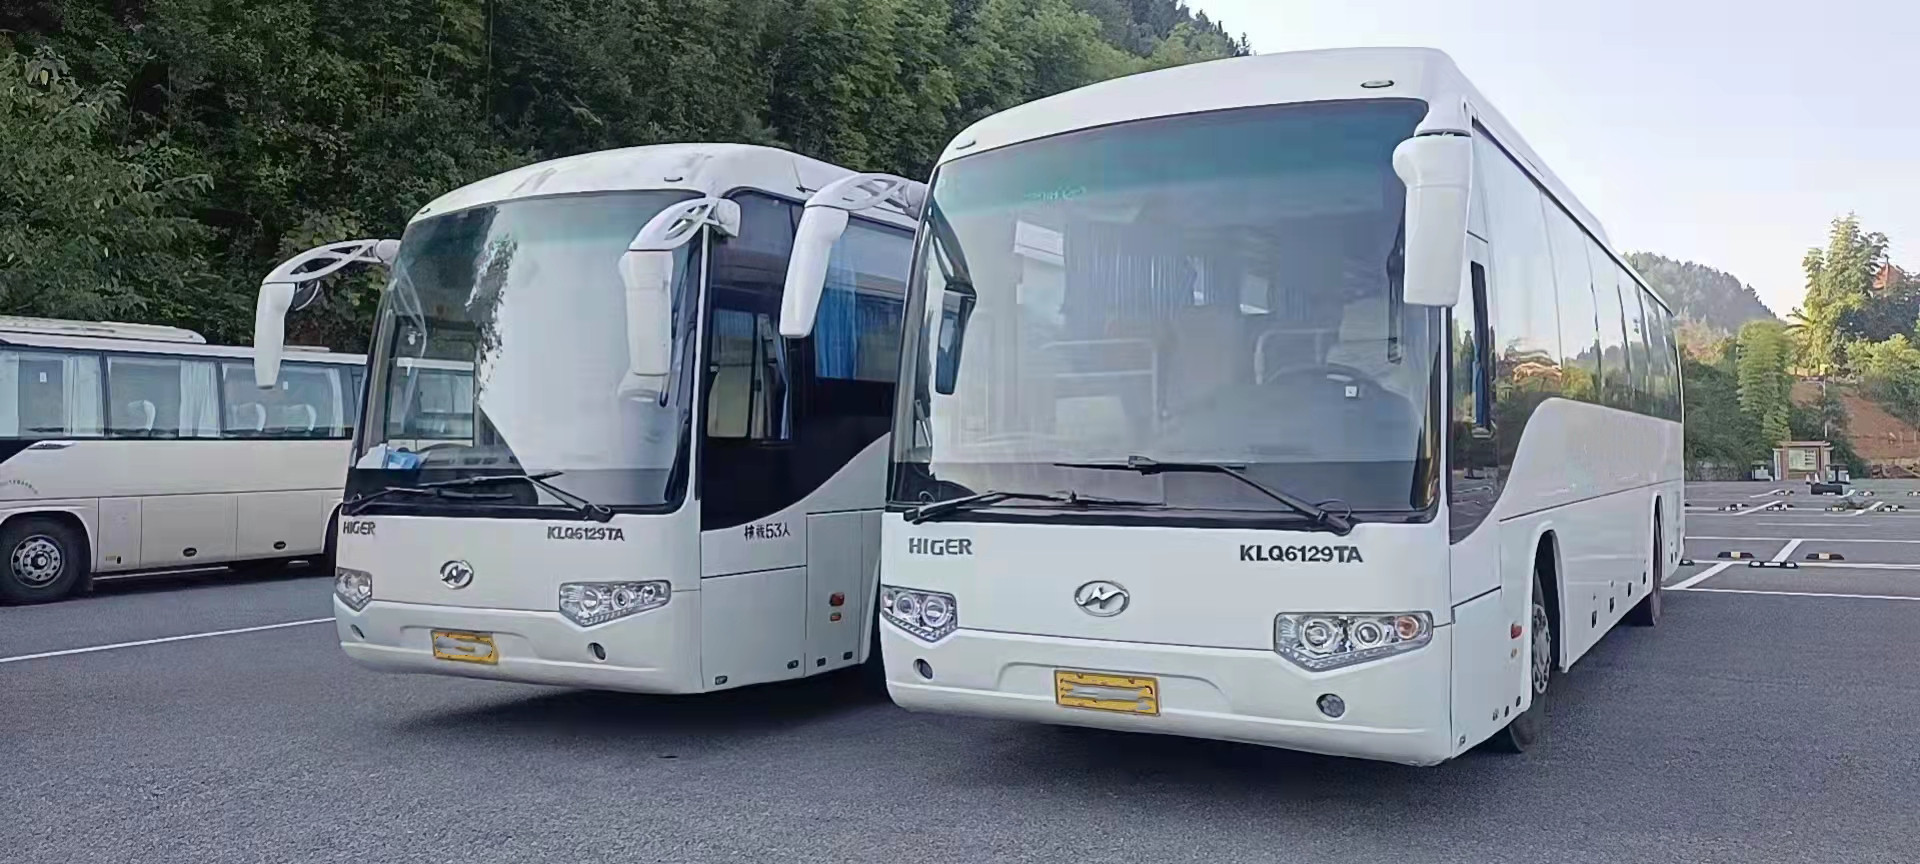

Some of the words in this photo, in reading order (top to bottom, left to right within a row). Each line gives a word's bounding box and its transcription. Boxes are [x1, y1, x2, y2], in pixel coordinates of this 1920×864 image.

[343, 521, 376, 535] HIGER
[547, 526, 625, 541] KLQ6129TA
[909, 538, 973, 555] HIGER
[1240, 545, 1364, 563] KLQ6129TA
